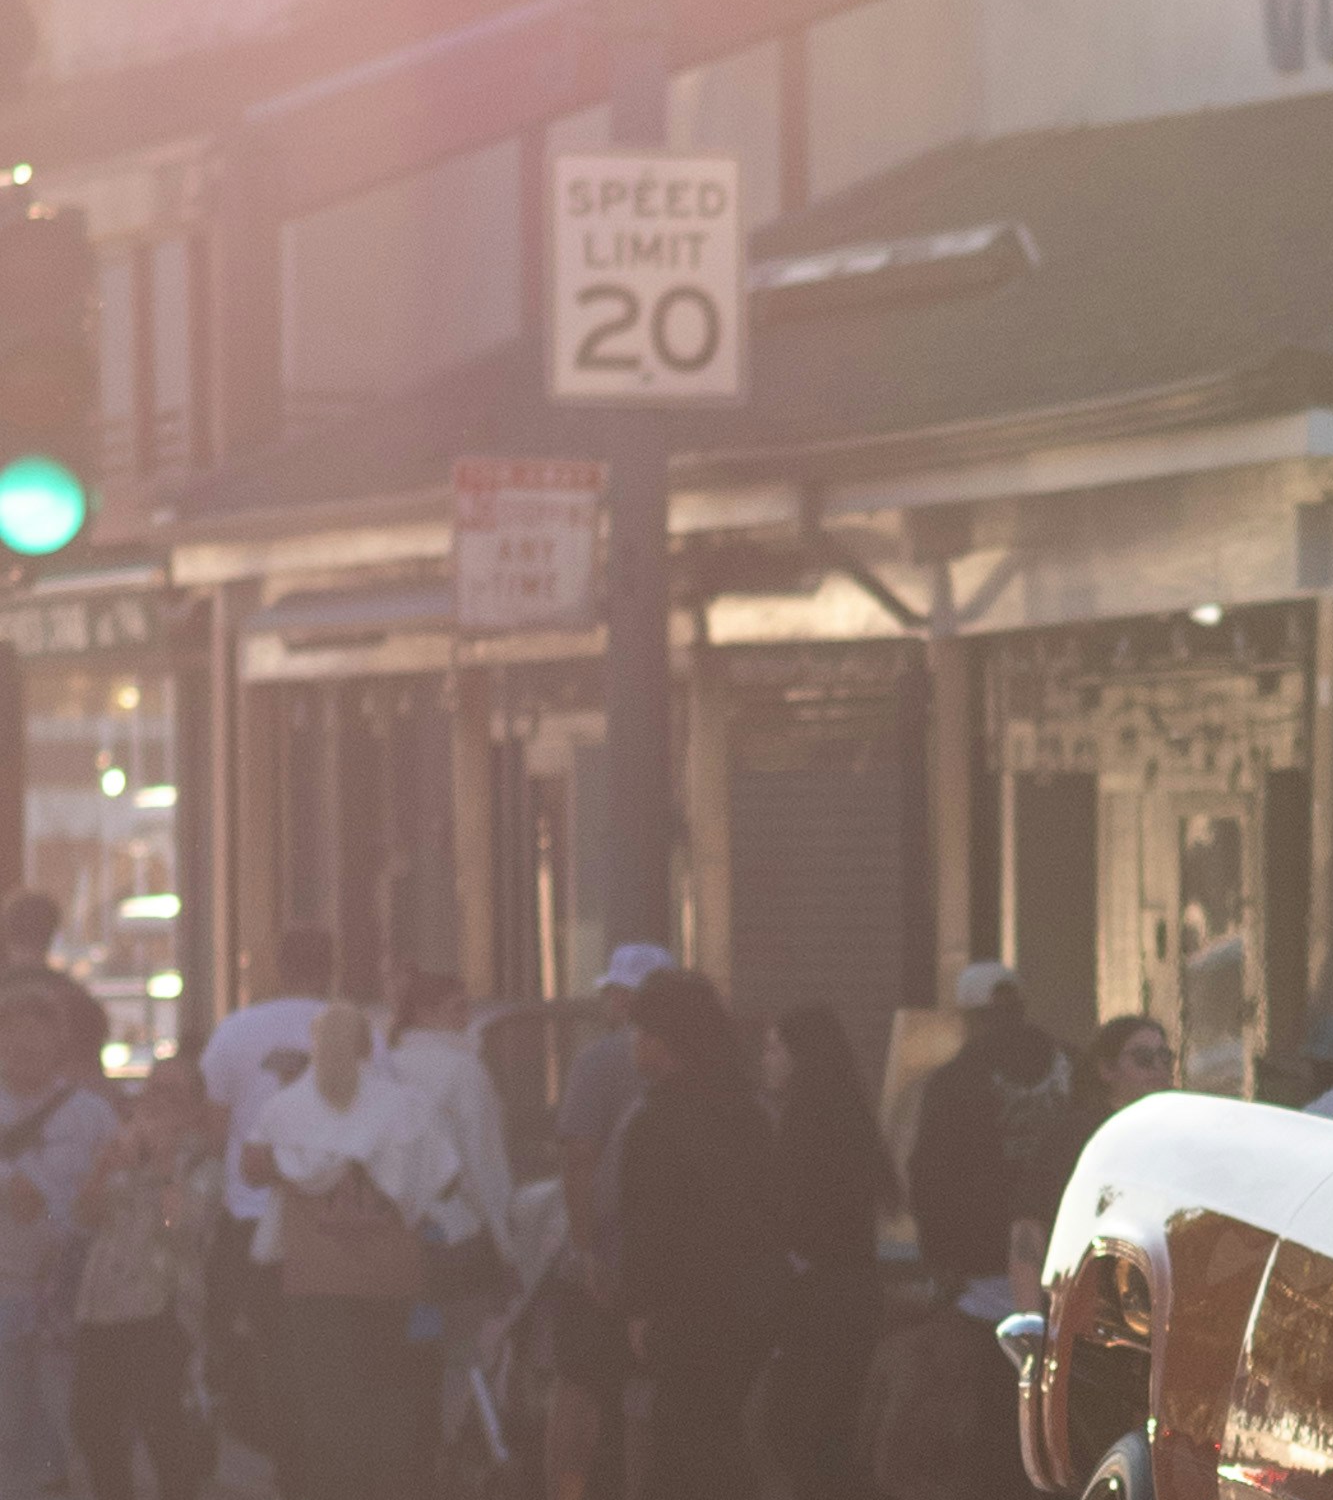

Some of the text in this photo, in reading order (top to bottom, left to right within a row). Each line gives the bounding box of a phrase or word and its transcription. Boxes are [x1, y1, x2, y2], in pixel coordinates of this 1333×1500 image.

[568, 178, 727, 219] SPEED
[583, 232, 709, 269] LIMIT
[574, 284, 721, 373] 20
